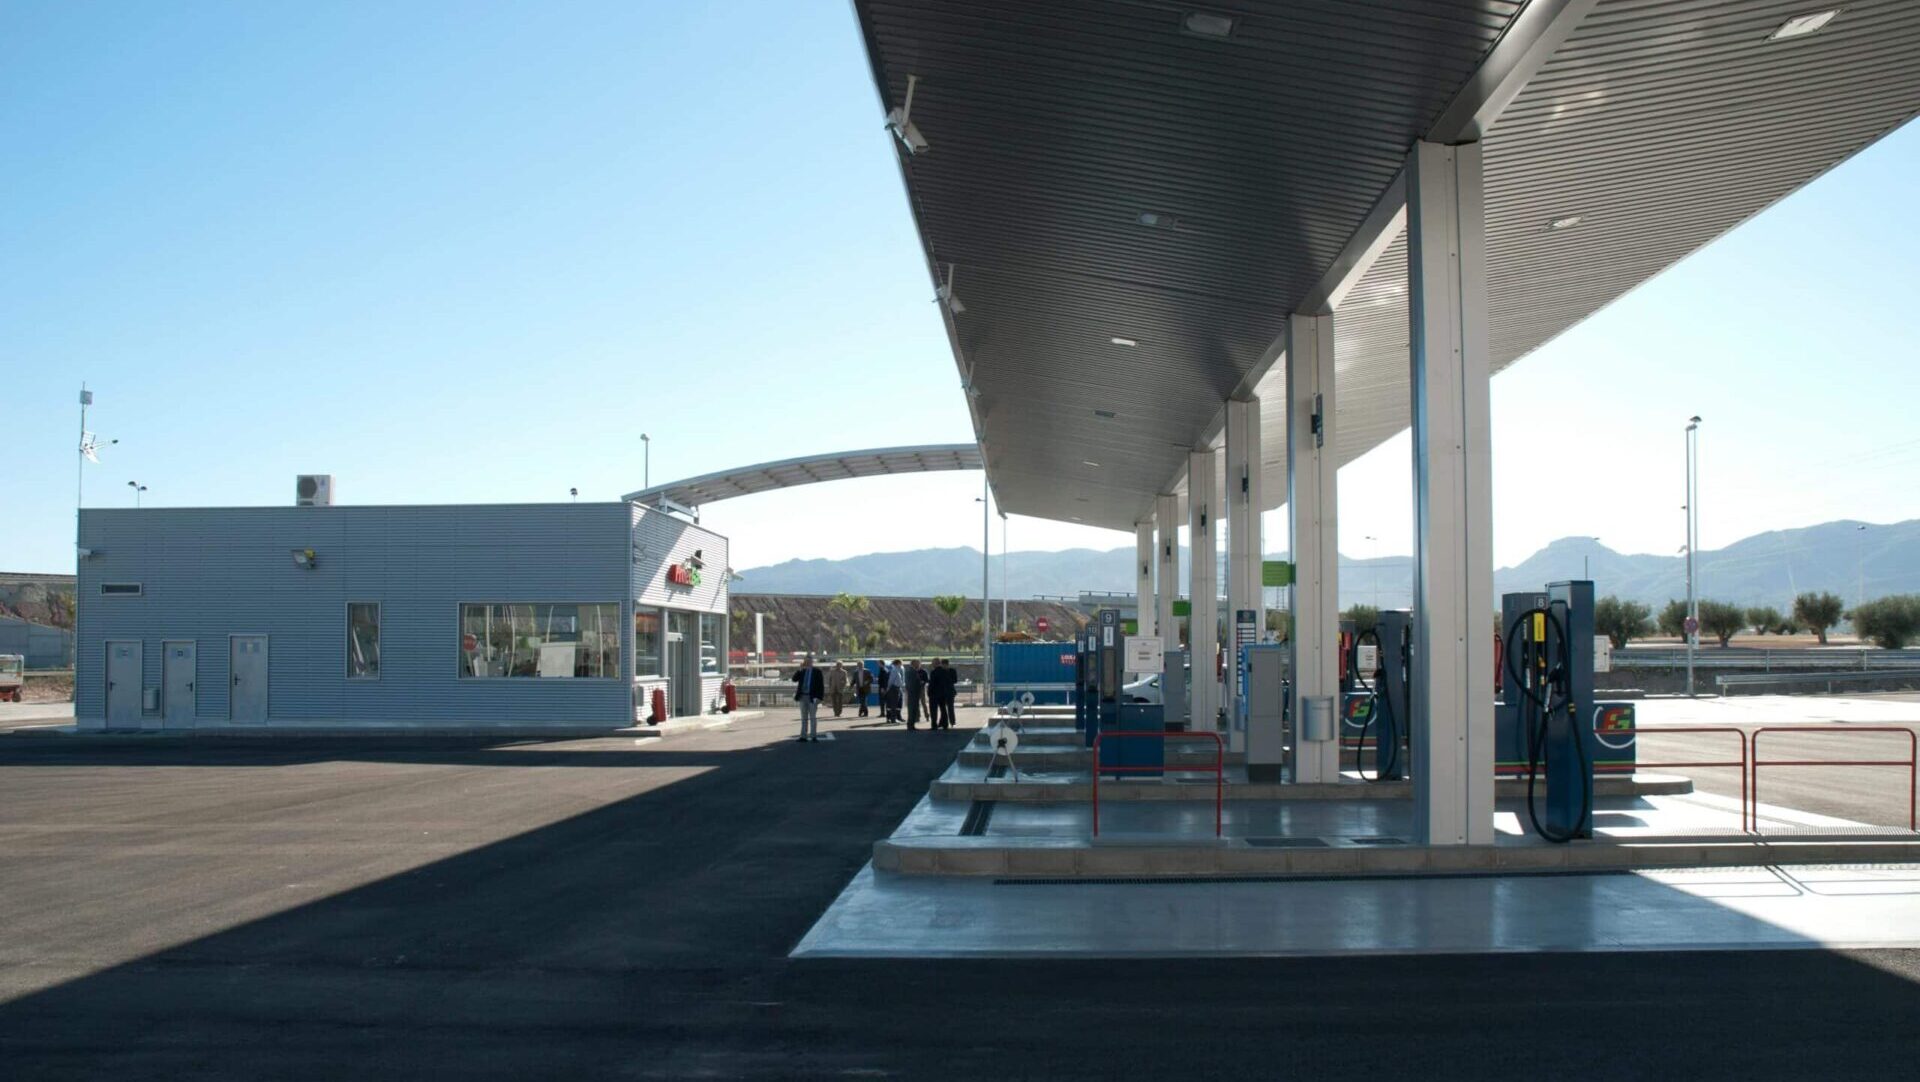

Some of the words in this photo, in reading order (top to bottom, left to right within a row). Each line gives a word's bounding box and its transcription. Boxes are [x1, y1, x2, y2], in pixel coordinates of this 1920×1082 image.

[1537, 598, 1545, 608] 8
[1105, 613, 1112, 623] 9
[1088, 626, 1097, 634] 10
